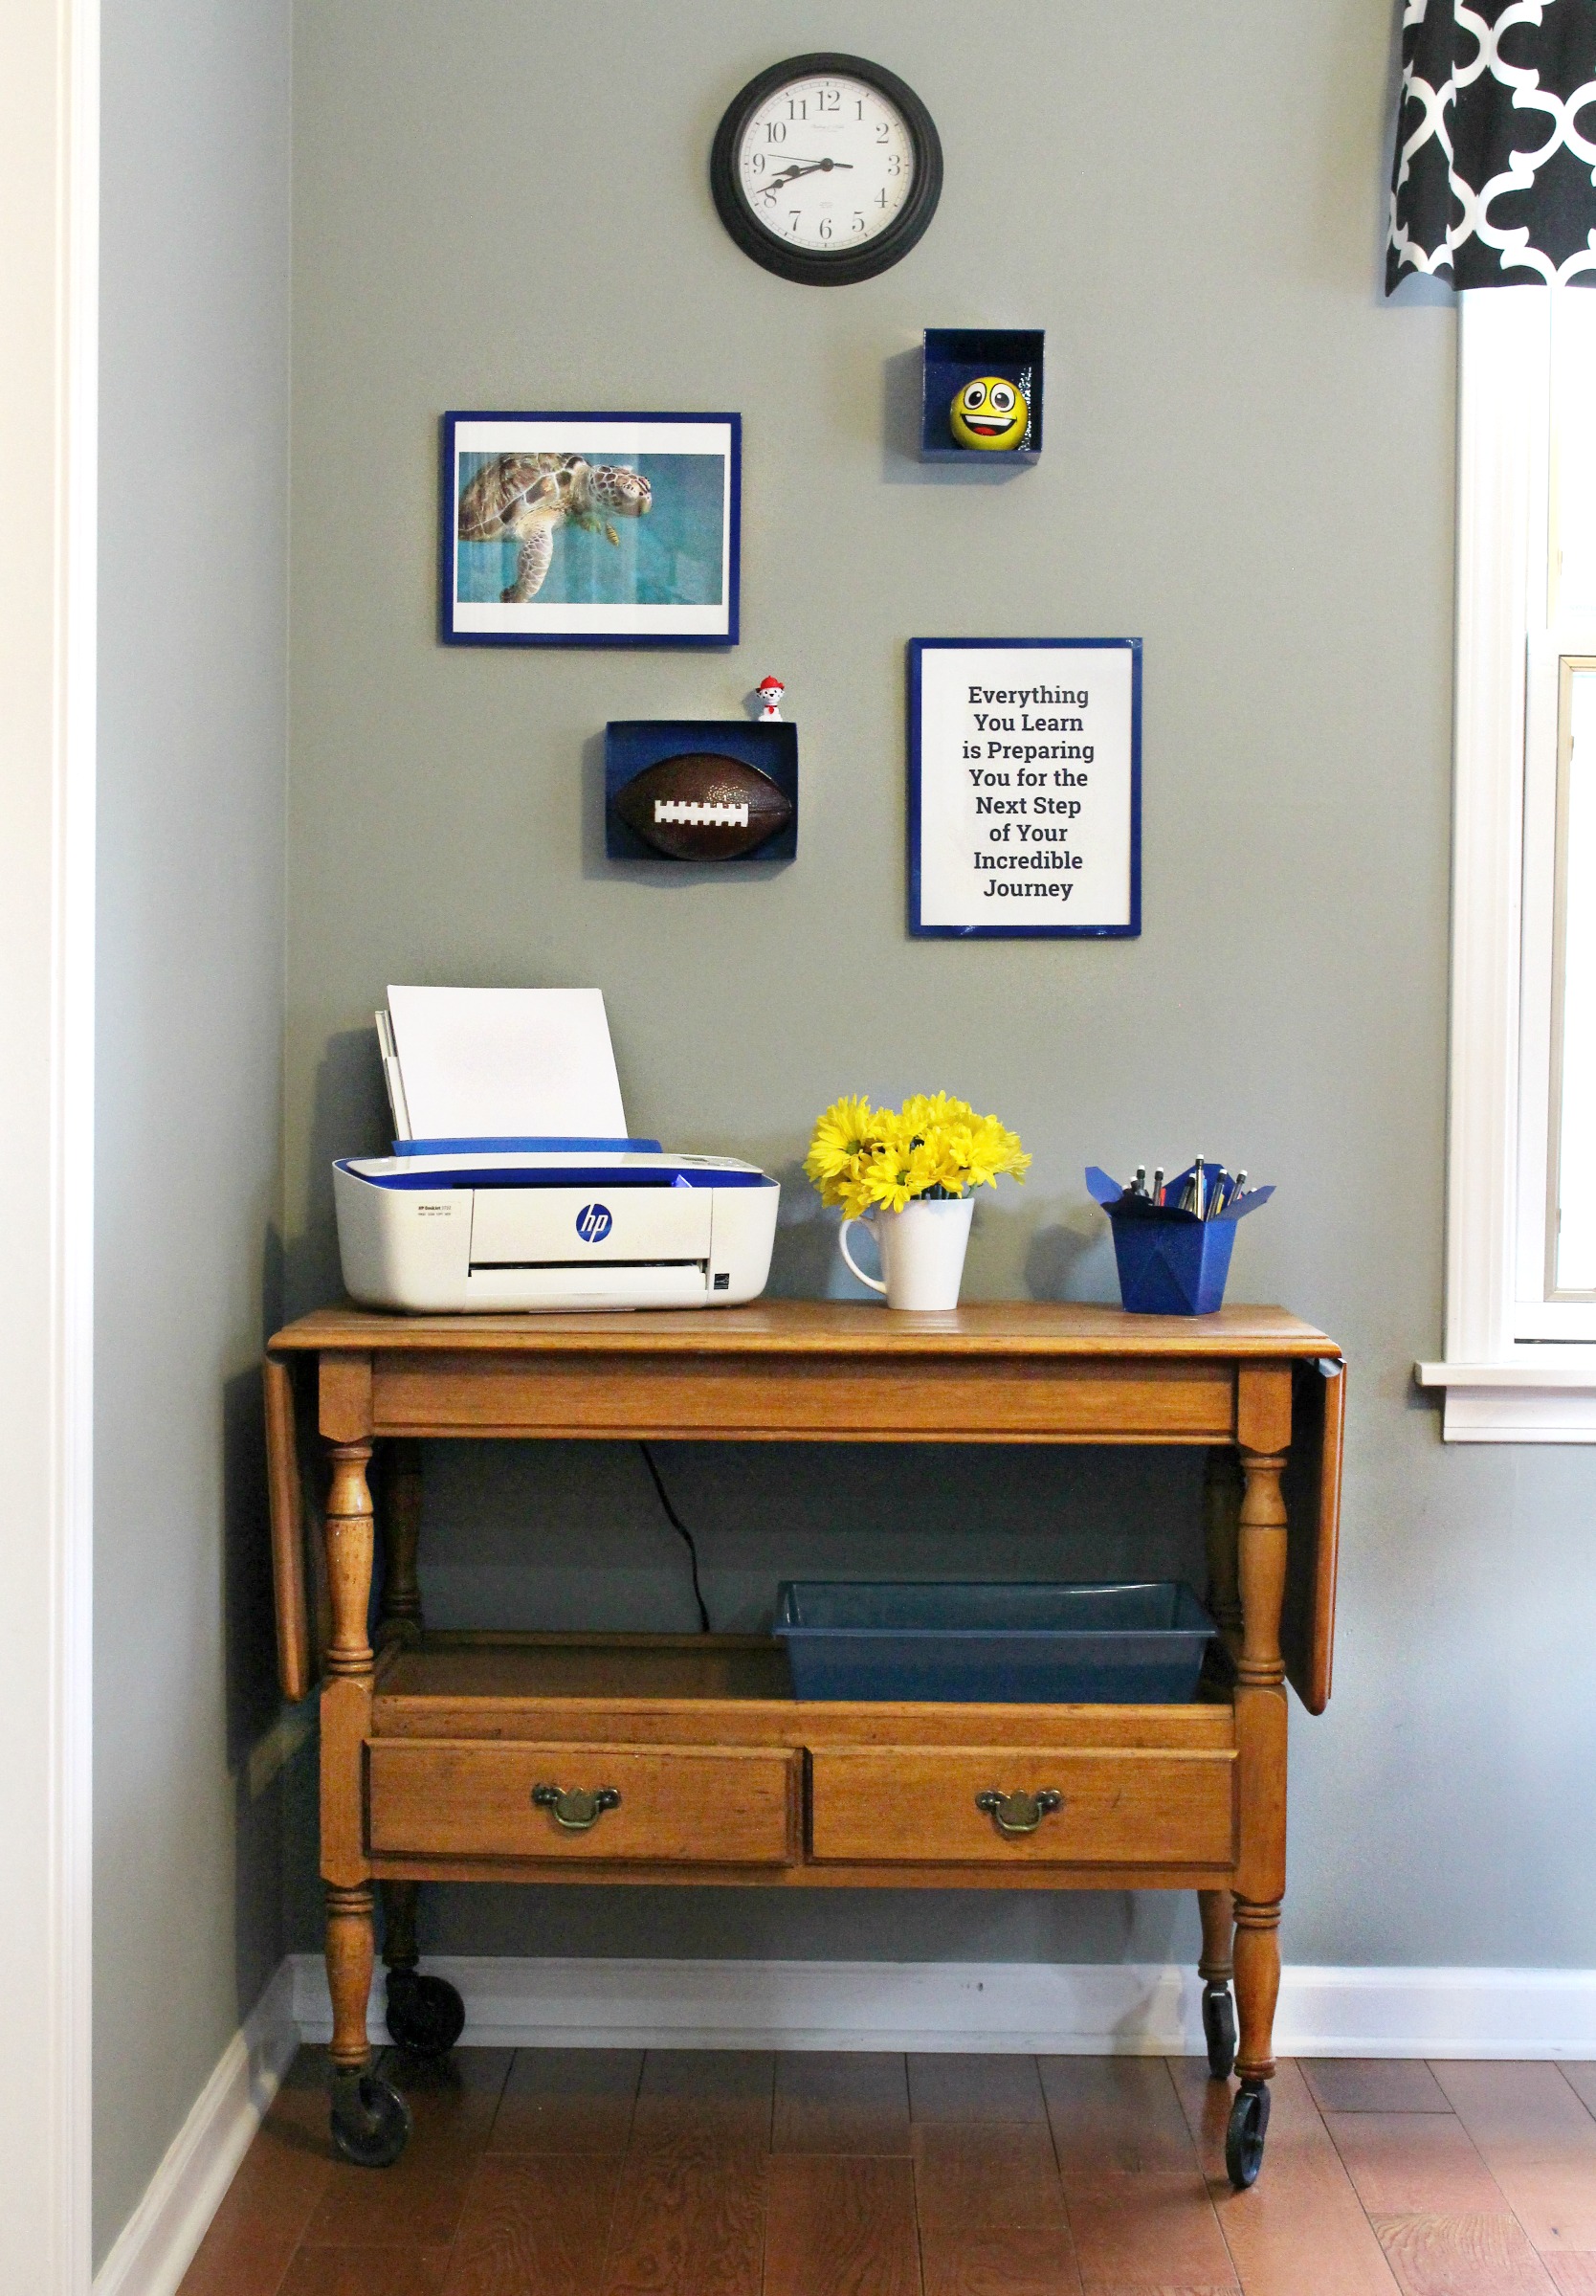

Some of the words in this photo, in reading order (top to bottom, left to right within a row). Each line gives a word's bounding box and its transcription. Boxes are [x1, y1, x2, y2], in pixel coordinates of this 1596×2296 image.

[787, 100, 809, 121] 11
[816, 90, 841, 111] 12
[854, 100, 865, 121] 1
[765, 122, 787, 144] 10
[876, 123, 890, 144] 2
[753, 153, 765, 174] 9
[887, 154, 901, 176] 3
[764, 187, 778, 209] 8
[875, 188, 889, 209] 4
[788, 211, 802, 232] 7
[819, 217, 832, 240] 6
[852, 212, 865, 233] 5
[968, 685, 1089, 708] Everything
[973, 714, 1015, 731] You
[1021, 714, 1084, 731] Learn
[963, 741, 981, 759] is
[987, 741, 1095, 763] Preparing
[969, 769, 1010, 787] You
[1016, 769, 1048, 787] for
[1053, 769, 1088, 787] the
[976, 796, 1027, 814] Next
[1033, 796, 1081, 818] Step
[989, 823, 1011, 841] of
[1016, 824, 1068, 841] Your
[973, 851, 1083, 869] Incredible
[983, 880, 1074, 902] Journey
[578, 1204, 610, 1242] hp
